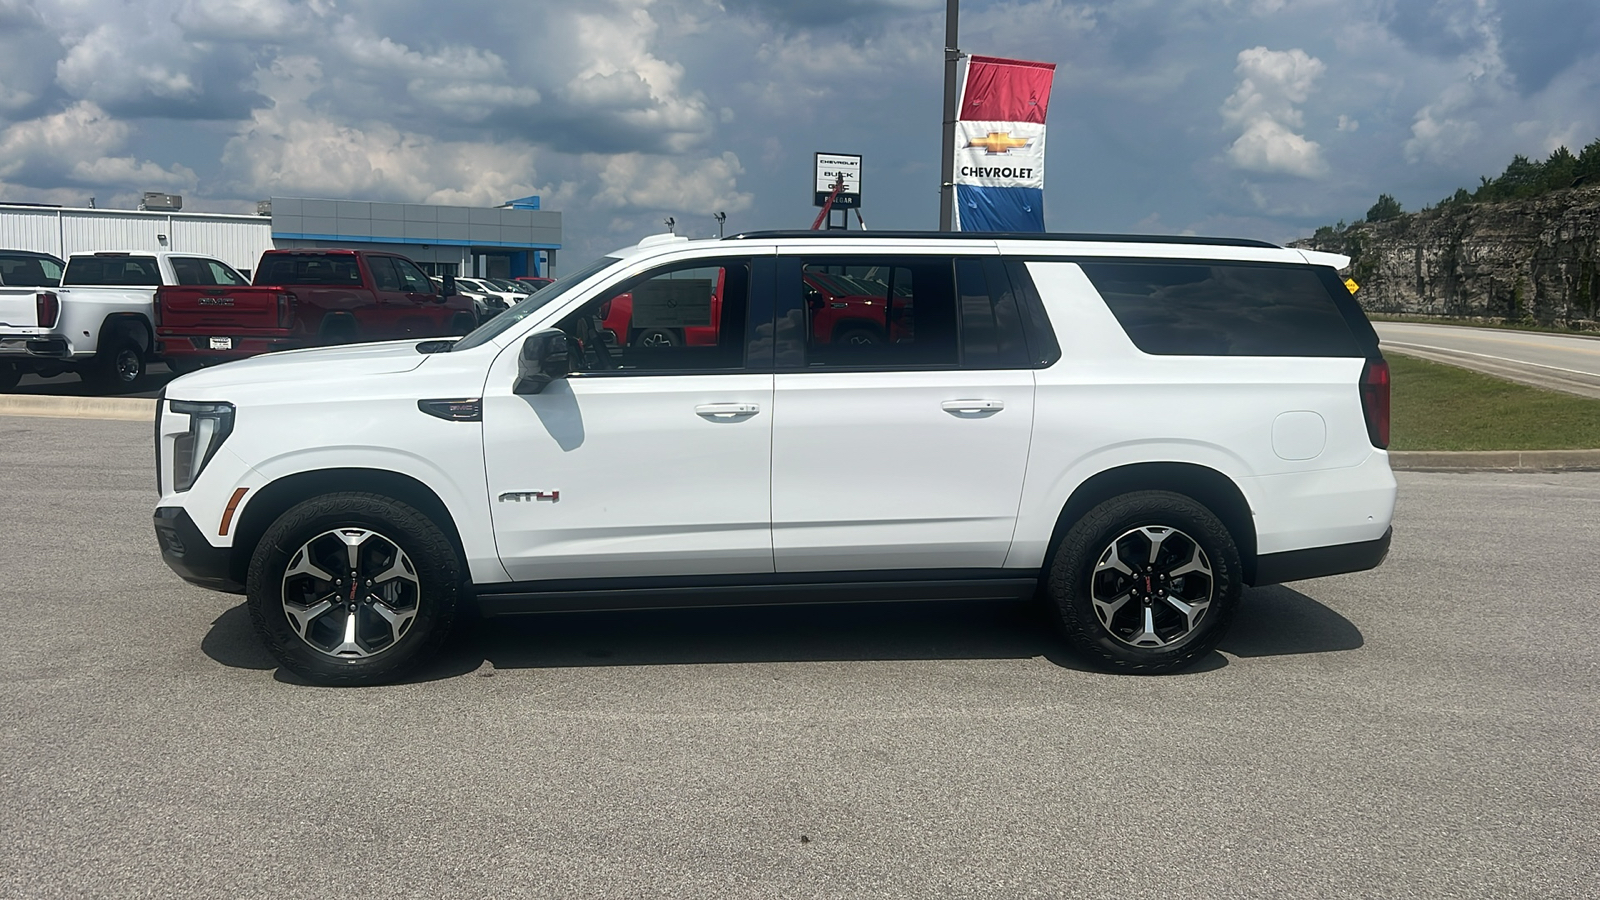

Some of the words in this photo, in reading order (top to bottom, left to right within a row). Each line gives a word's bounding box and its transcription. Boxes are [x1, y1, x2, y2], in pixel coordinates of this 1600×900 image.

[961, 166, 1033, 179] CHEVROLET
[828, 183, 850, 191] GC
[198, 297, 235, 306] GMC
[498, 491, 560, 504] AT4
